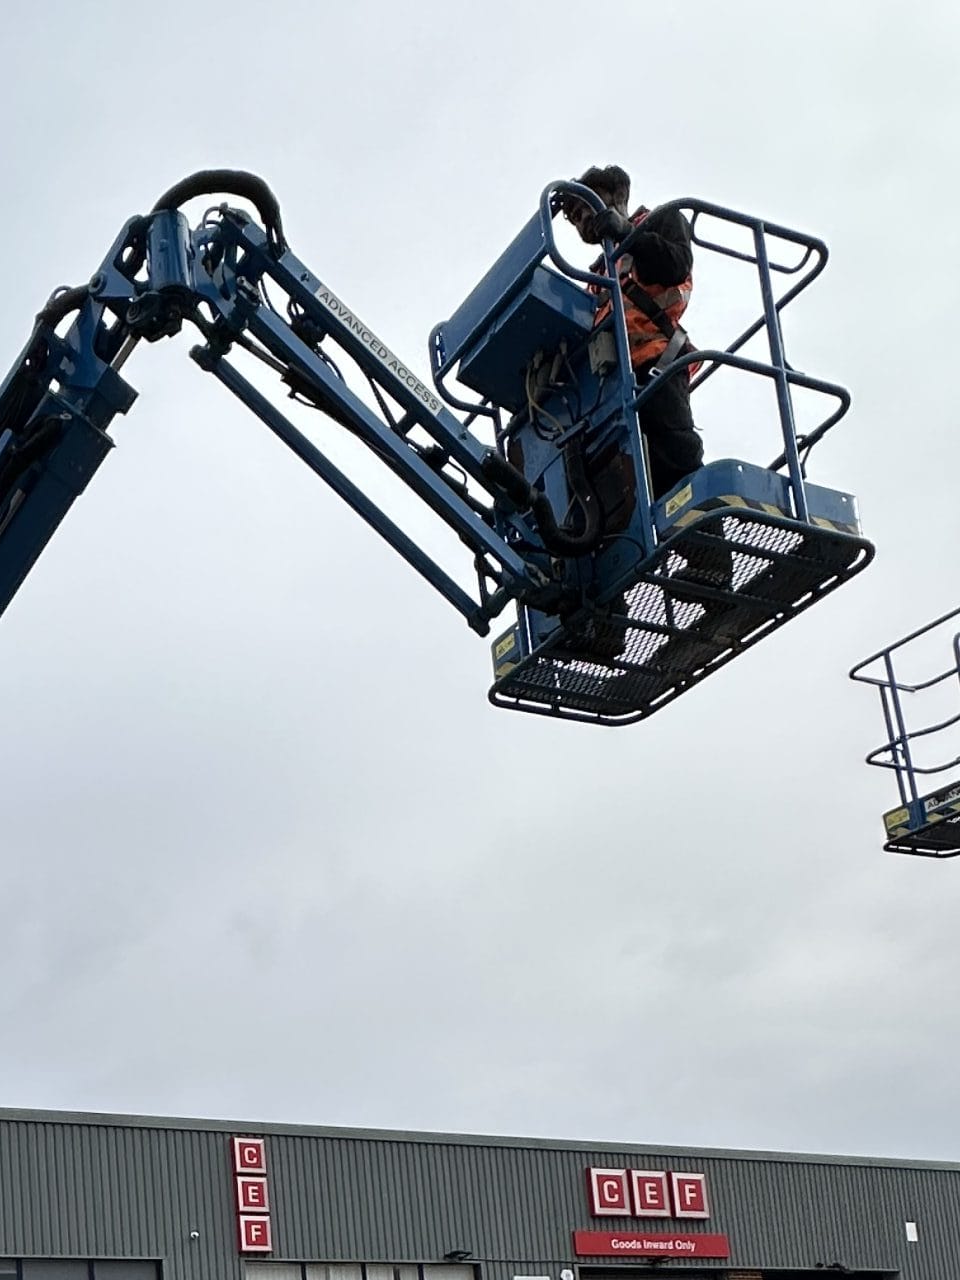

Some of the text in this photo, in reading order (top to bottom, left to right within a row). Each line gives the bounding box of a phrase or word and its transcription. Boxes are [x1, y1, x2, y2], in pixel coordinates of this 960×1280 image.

[320, 292, 439, 411] ADVANCED ACCESS
[603, 1180, 697, 1206] CEF
[611, 1239, 696, 1252] Goods Inward Only
